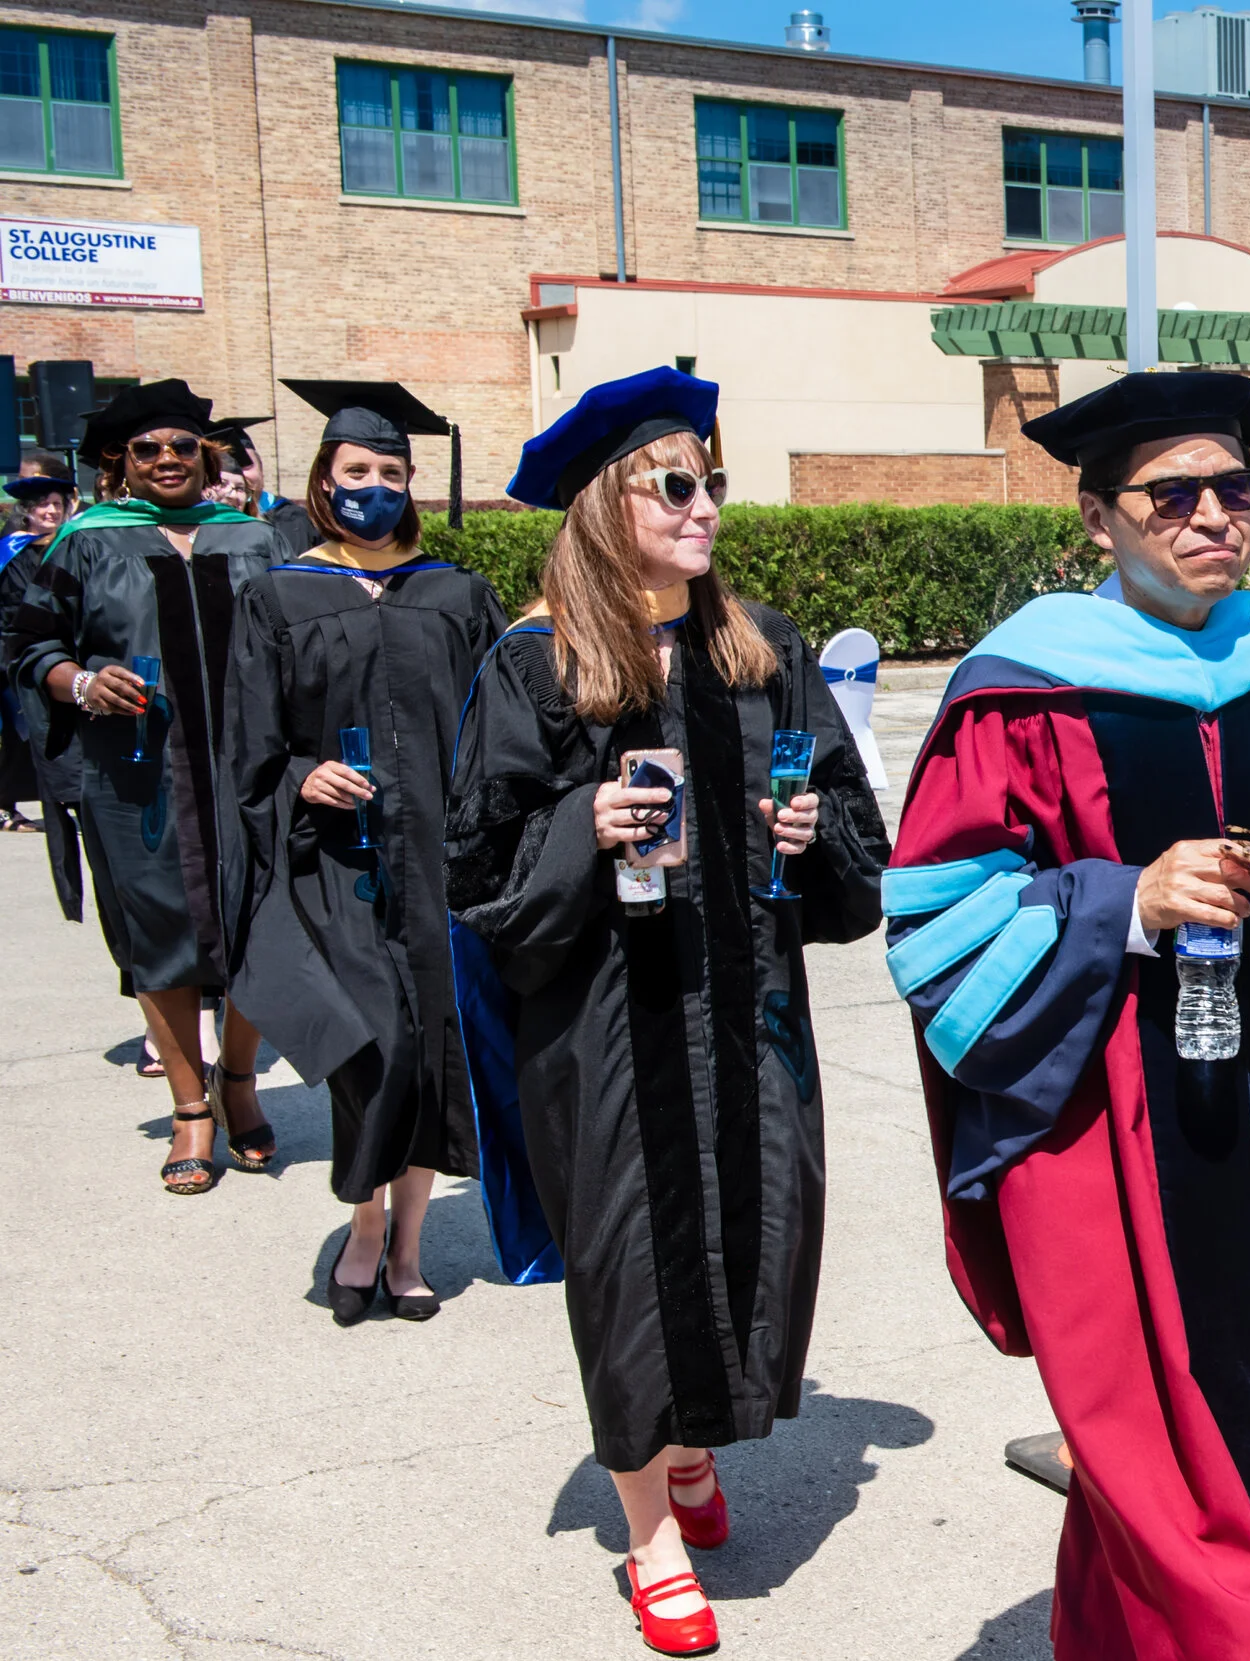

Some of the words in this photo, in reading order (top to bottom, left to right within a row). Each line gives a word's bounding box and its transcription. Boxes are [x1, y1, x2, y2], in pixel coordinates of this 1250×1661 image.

[9, 229, 33, 244] ST.
[39, 230, 156, 250] AUGUSTINE
[10, 245, 99, 263] COLLEGE
[9, 288, 91, 303] BIENVENIDOS
